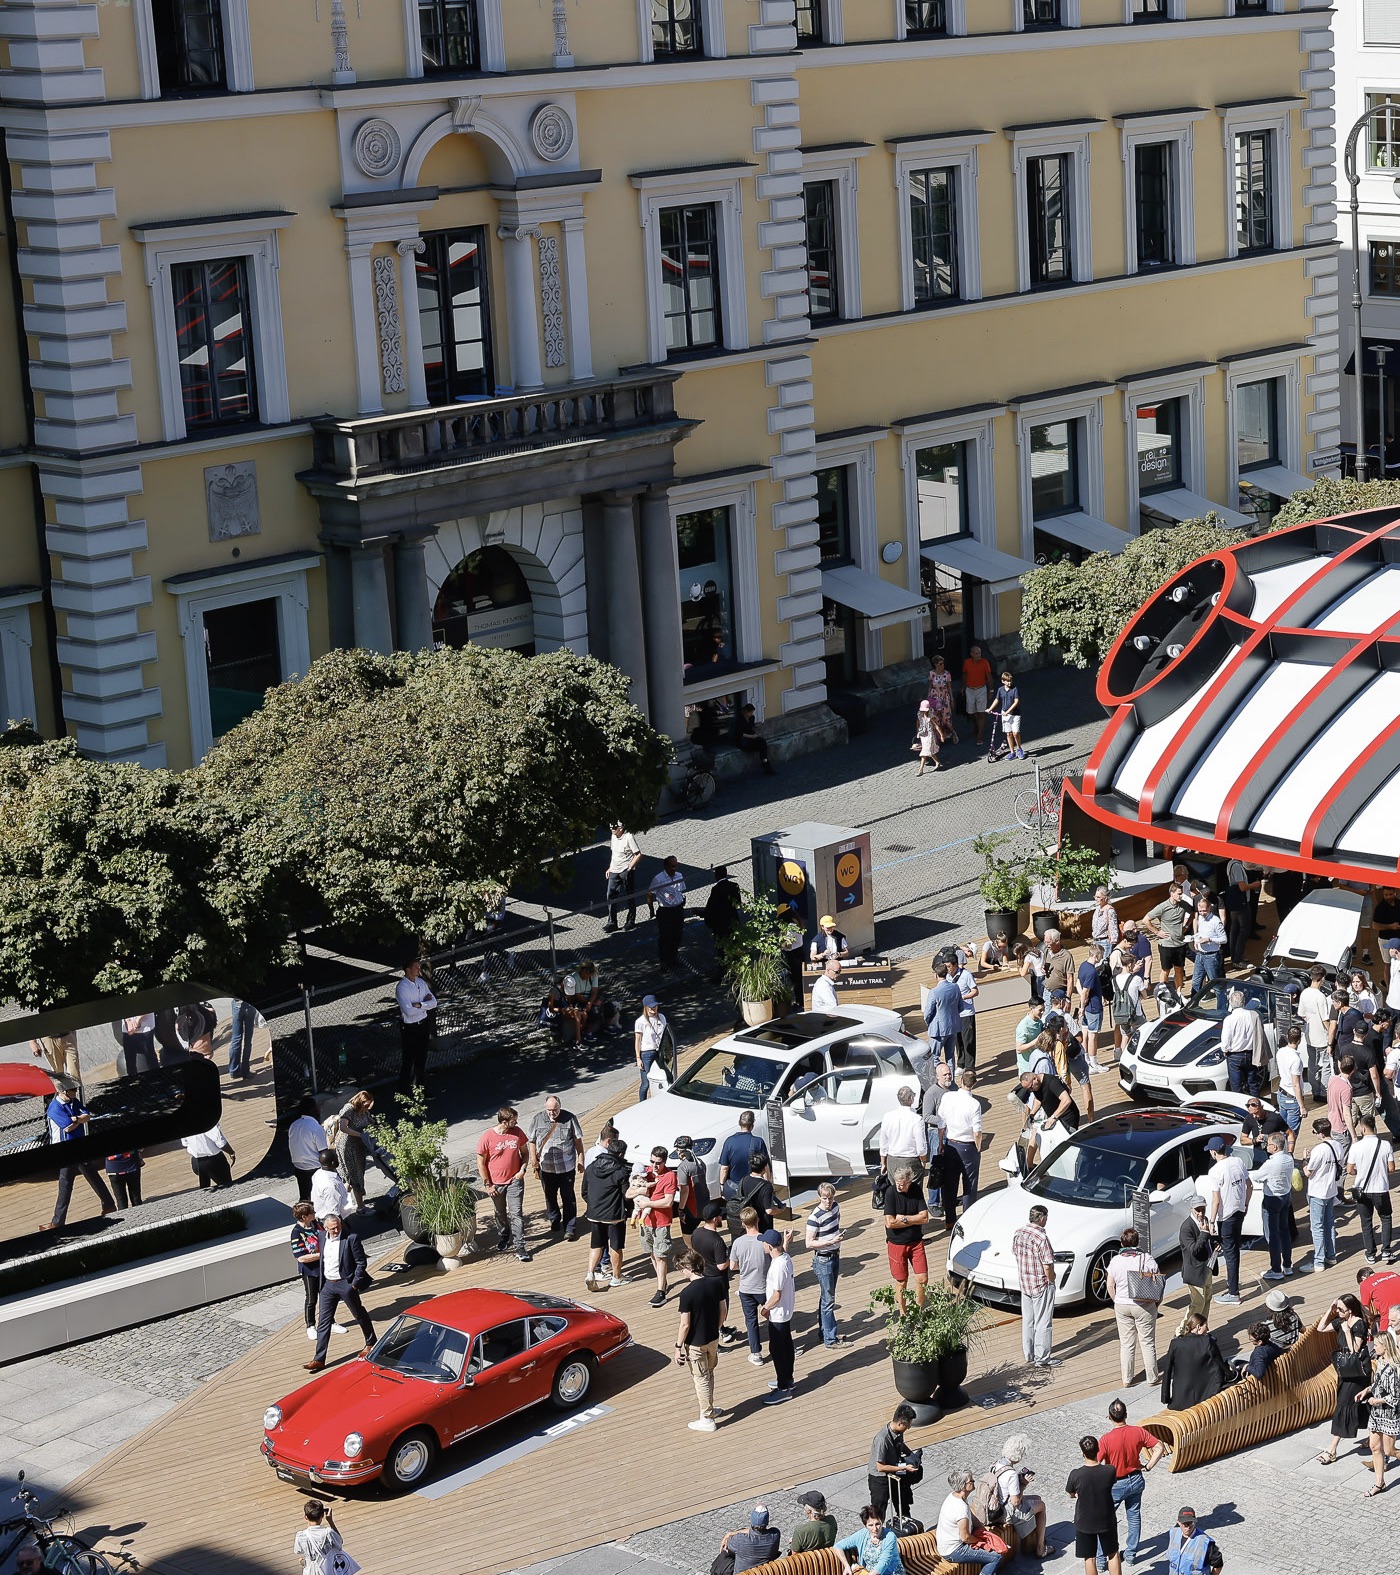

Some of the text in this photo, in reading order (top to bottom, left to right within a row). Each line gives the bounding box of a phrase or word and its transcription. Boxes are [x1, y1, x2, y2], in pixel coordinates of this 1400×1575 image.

[1141, 458, 1167, 472] design
[840, 865, 855, 877] WC
[783, 874, 798, 883] WC
